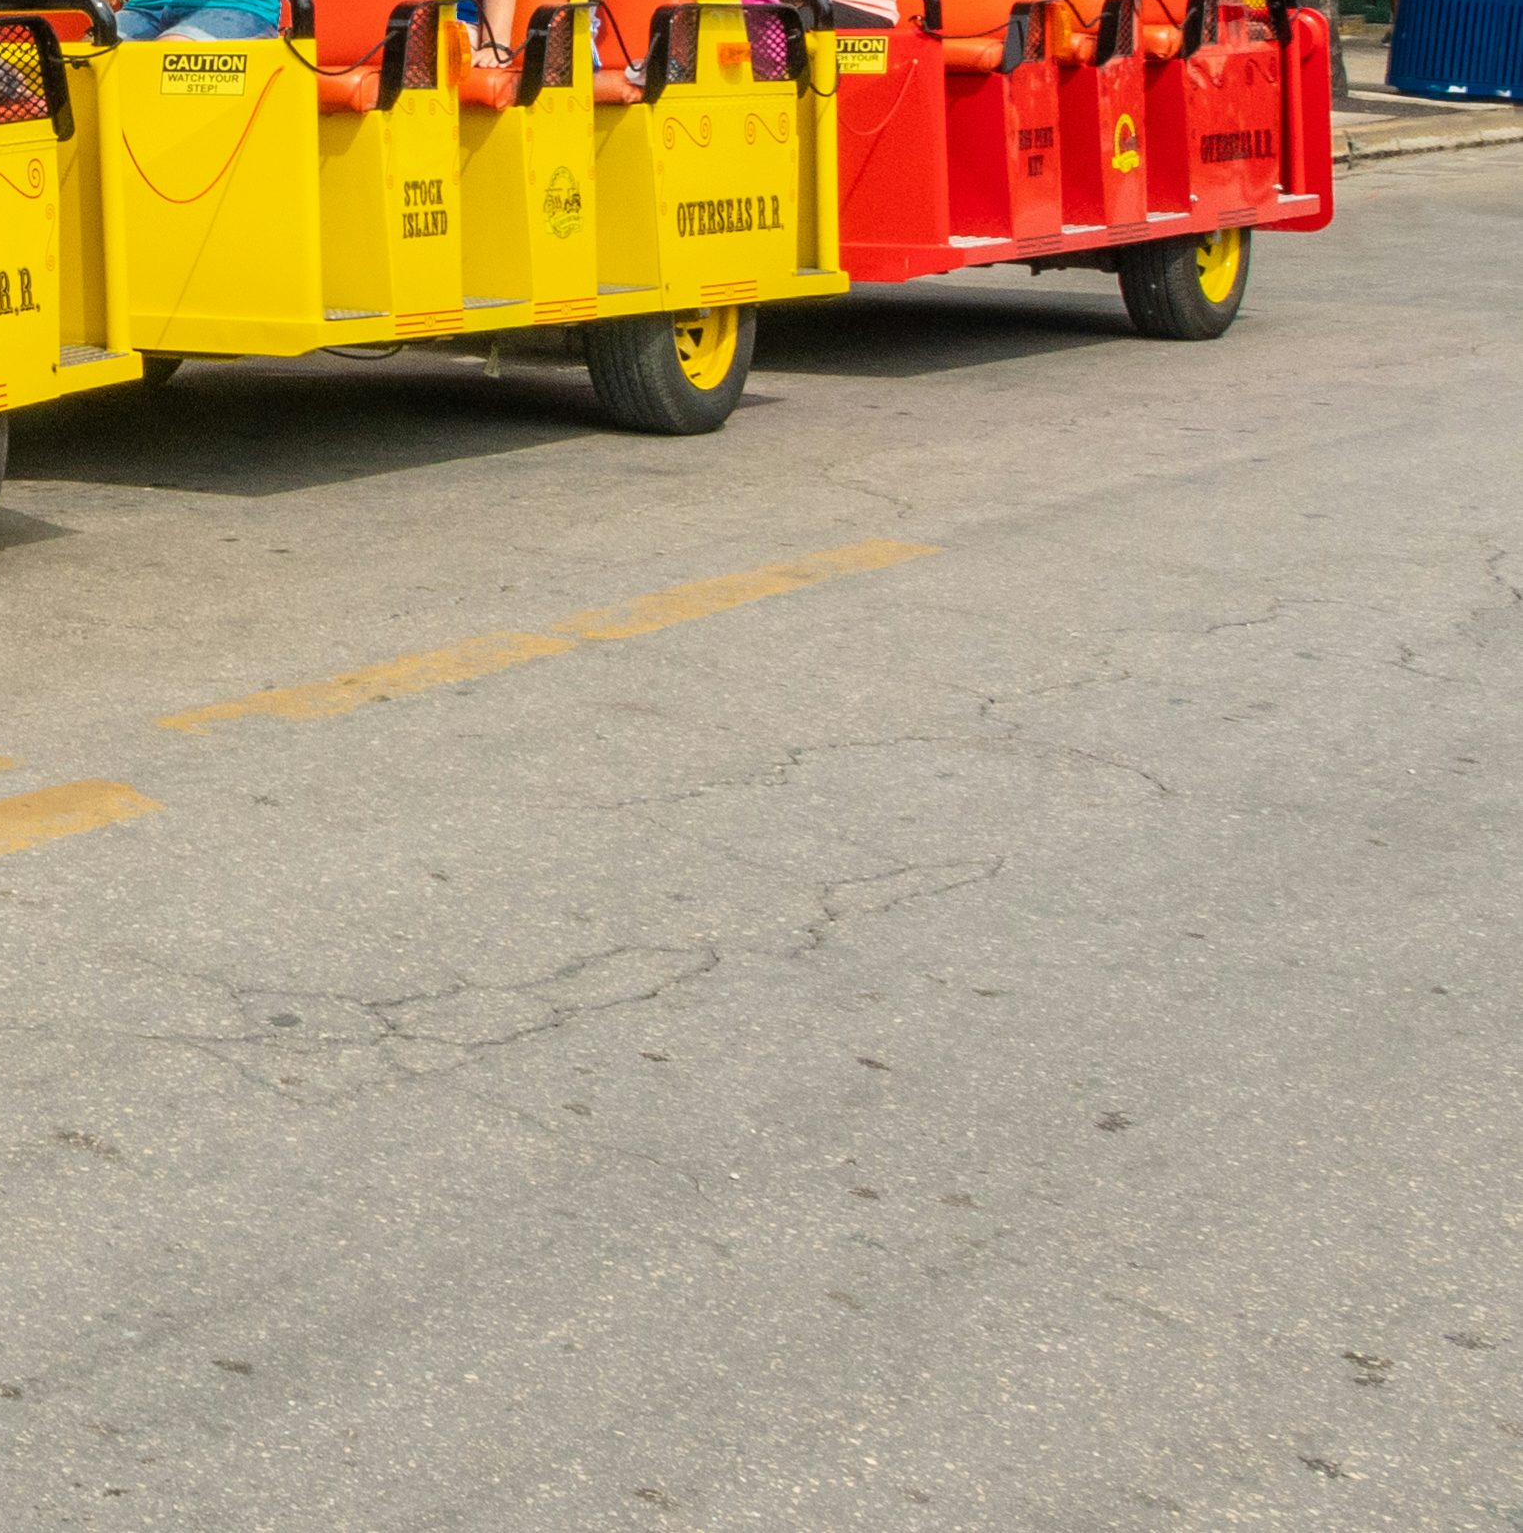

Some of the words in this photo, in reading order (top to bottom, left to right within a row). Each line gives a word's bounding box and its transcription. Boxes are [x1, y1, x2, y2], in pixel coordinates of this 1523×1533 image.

[164, 55, 245, 71] CAUTION
[167, 73, 206, 83] WATCH
[208, 74, 239, 83] YOUR
[186, 83, 218, 93] STEP!
[403, 179, 444, 207] STOCK
[401, 209, 448, 239] ISLAND
[676, 197, 753, 238] OVERSEAS
